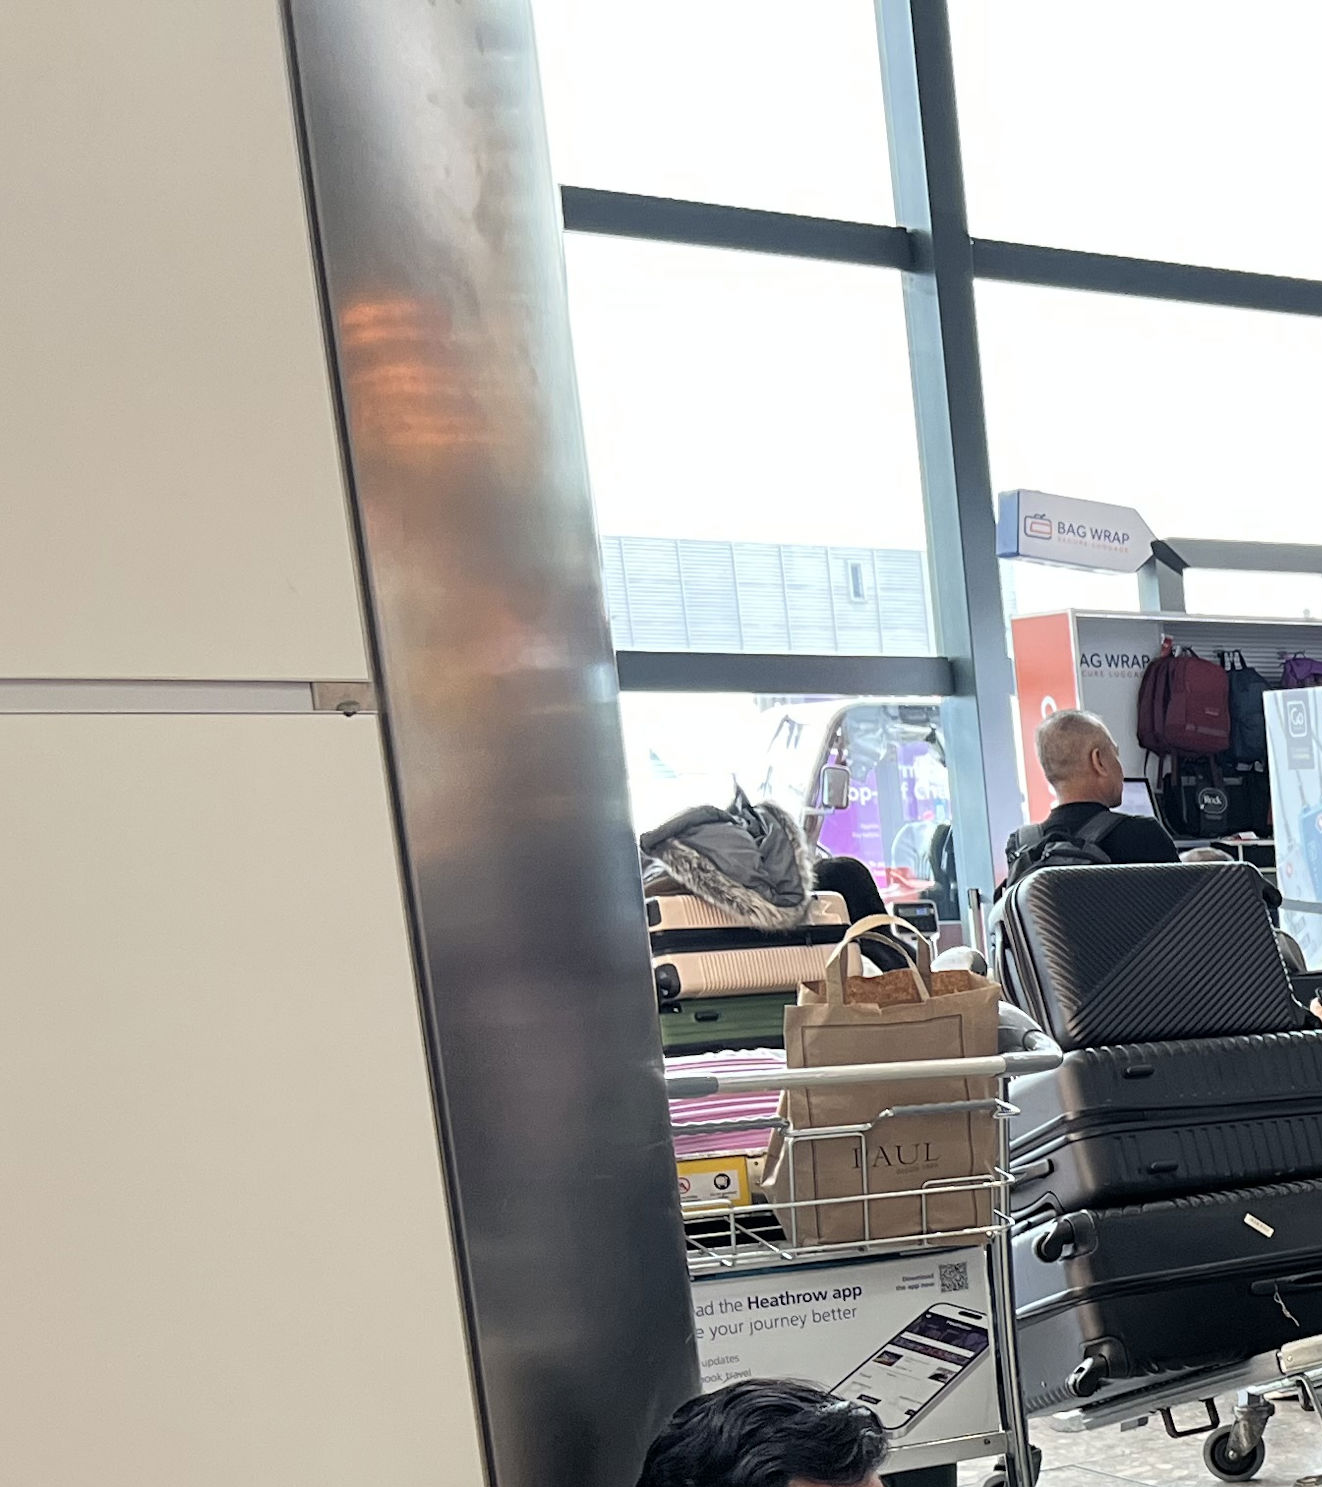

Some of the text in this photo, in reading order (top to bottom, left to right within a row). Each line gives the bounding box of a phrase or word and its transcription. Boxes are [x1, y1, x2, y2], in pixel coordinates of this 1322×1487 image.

[1057, 521, 1130, 545] BAG WRAP
[1080, 653, 1151, 668] AG WRAP
[719, 1296, 743, 1314] the
[747, 1288, 828, 1311] Heathrow
[832, 1284, 863, 1304] app
[709, 1319, 744, 1341] your
[749, 1314, 807, 1336] journey
[812, 1306, 858, 1324] better
[701, 1354, 740, 1368] updates
